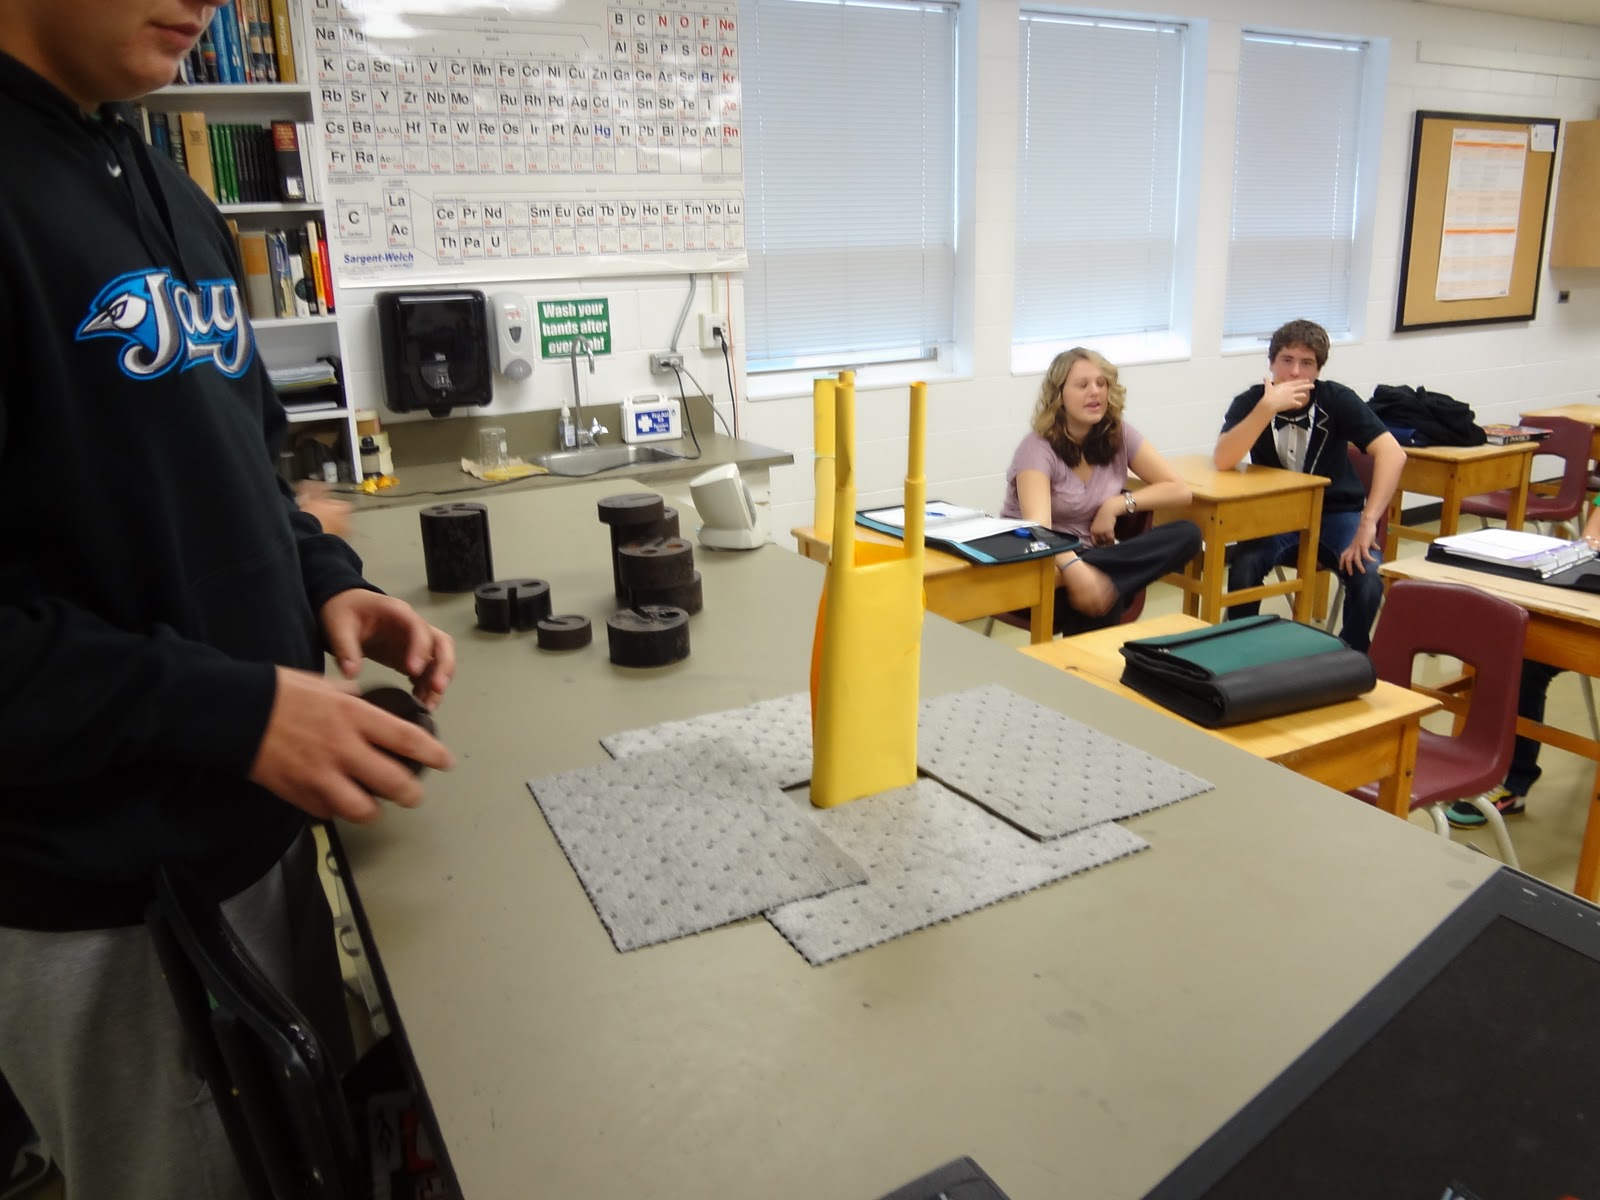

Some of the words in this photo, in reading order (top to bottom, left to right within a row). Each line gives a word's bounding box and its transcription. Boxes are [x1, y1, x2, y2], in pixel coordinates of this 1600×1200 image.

[614, 13, 624, 25] B
[637, 14, 646, 26] C
[658, 15, 667, 27] N
[680, 16, 689, 28] O
[702, 17, 710, 29] F
[719, 18, 735, 31] Ne
[315, 27, 335, 40] Na
[614, 42, 627, 53] Al
[637, 42, 648, 54] Si
[660, 43, 669, 55] P
[682, 44, 690, 56] S
[701, 45, 713, 57] Cl
[721, 46, 735, 58] Ar
[323, 59, 335, 71] K
[346, 60, 366, 72] Ca
[373, 61, 392, 73] Sc
[403, 61, 415, 73] Ti
[428, 62, 438, 74] V
[451, 63, 467, 75] Cr
[473, 64, 492, 76] Mn
[499, 65, 515, 77] Fe
[522, 65, 540, 77] Co
[549, 66, 561, 78] Ni
[568, 68, 586, 79] Cu
[592, 68, 608, 80] Zn
[613, 69, 630, 81] Ga
[635, 70, 652, 81] Ge
[658, 70, 673, 82] As
[679, 70, 694, 83] Se
[701, 71, 715, 83] Br
[722, 71, 735, 83] Kr
[322, 90, 342, 102] Rb
[351, 91, 367, 103] Sr
[380, 91, 390, 103] Y
[403, 92, 419, 104] Zr
[427, 92, 446, 104] Nb
[451, 93, 469, 105] Mo
[500, 94, 517, 106] Ru
[524, 95, 542, 106] Rh
[549, 95, 564, 107] Pd
[571, 96, 588, 111] Ag
[593, 97, 609, 108] Cd
[617, 97, 629, 109] In
[637, 98, 653, 109] Sn
[659, 98, 675, 109] Sb
[681, 98, 695, 110] Te
[325, 121, 345, 134] Cs
[352, 121, 372, 134] Ba
[406, 122, 421, 134] Hf
[431, 122, 447, 134] Ta
[457, 122, 470, 134] W
[479, 123, 495, 135] Re
[502, 123, 519, 135] Os
[530, 124, 540, 135] Ir
[552, 124, 565, 136] Pt
[572, 124, 589, 136] Au
[594, 124, 611, 138] Hg
[619, 124, 630, 136] Tl
[638, 125, 654, 136] Pb
[662, 125, 674, 137] Bi
[682, 125, 697, 137] Po
[704, 126, 717, 137] At
[723, 126, 739, 137] Rn
[331, 151, 346, 163] Fr
[355, 151, 375, 163] Ra
[389, 195, 405, 207] La
[436, 208, 455, 220] Ce
[463, 208, 478, 219] Pr
[484, 207, 502, 219] Nd
[530, 207, 550, 218] Sm
[555, 206, 571, 218] Eu
[576, 206, 594, 218] Gd
[600, 205, 615, 217] Tb
[621, 205, 637, 219] Dy
[642, 205, 659, 216] Ho
[666, 205, 679, 216] Er
[684, 205, 702, 215] Tm
[706, 204, 721, 215] Yb
[726, 204, 741, 215] Lu
[348, 211, 360, 224] C
[391, 224, 409, 236] Ac
[440, 237, 457, 248] Th
[464, 237, 480, 248] Pa
[491, 236, 501, 248] U
[344, 252, 414, 265] Sargent-Welch
[542, 302, 577, 318] Wash
[578, 302, 604, 318] your
[542, 320, 579, 337] hands
[580, 319, 608, 334] after
